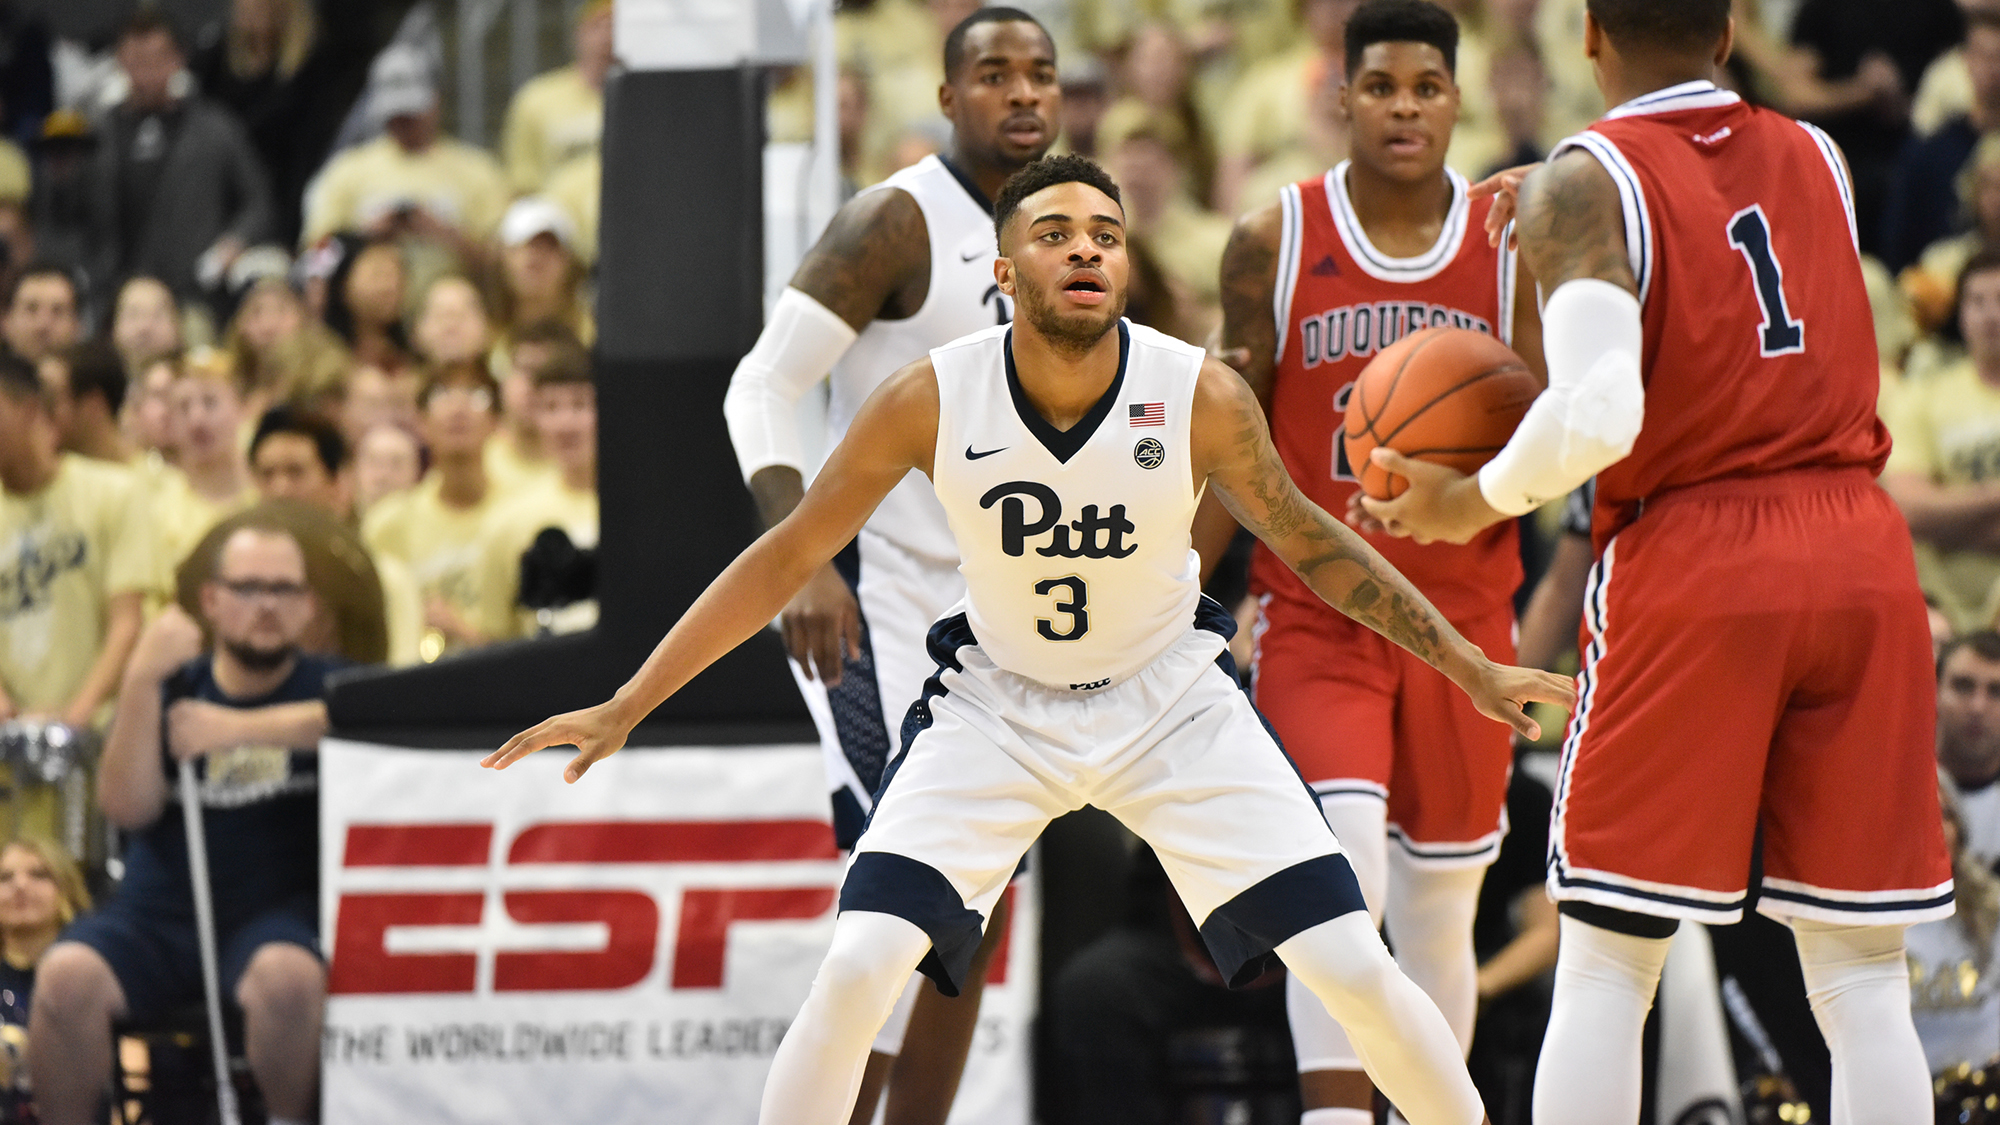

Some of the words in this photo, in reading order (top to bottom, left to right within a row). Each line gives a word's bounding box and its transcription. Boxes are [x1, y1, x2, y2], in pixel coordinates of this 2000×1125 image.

[1725, 203, 1805, 358] 1
[1301, 301, 1492, 370] DUQUE
[979, 480, 1138, 559] Pitt
[1032, 572, 1091, 643] 3
[328, 820, 1016, 995] ESP
[321, 1023, 391, 1063] THE
[404, 1021, 631, 1063] WORLDWIDE
